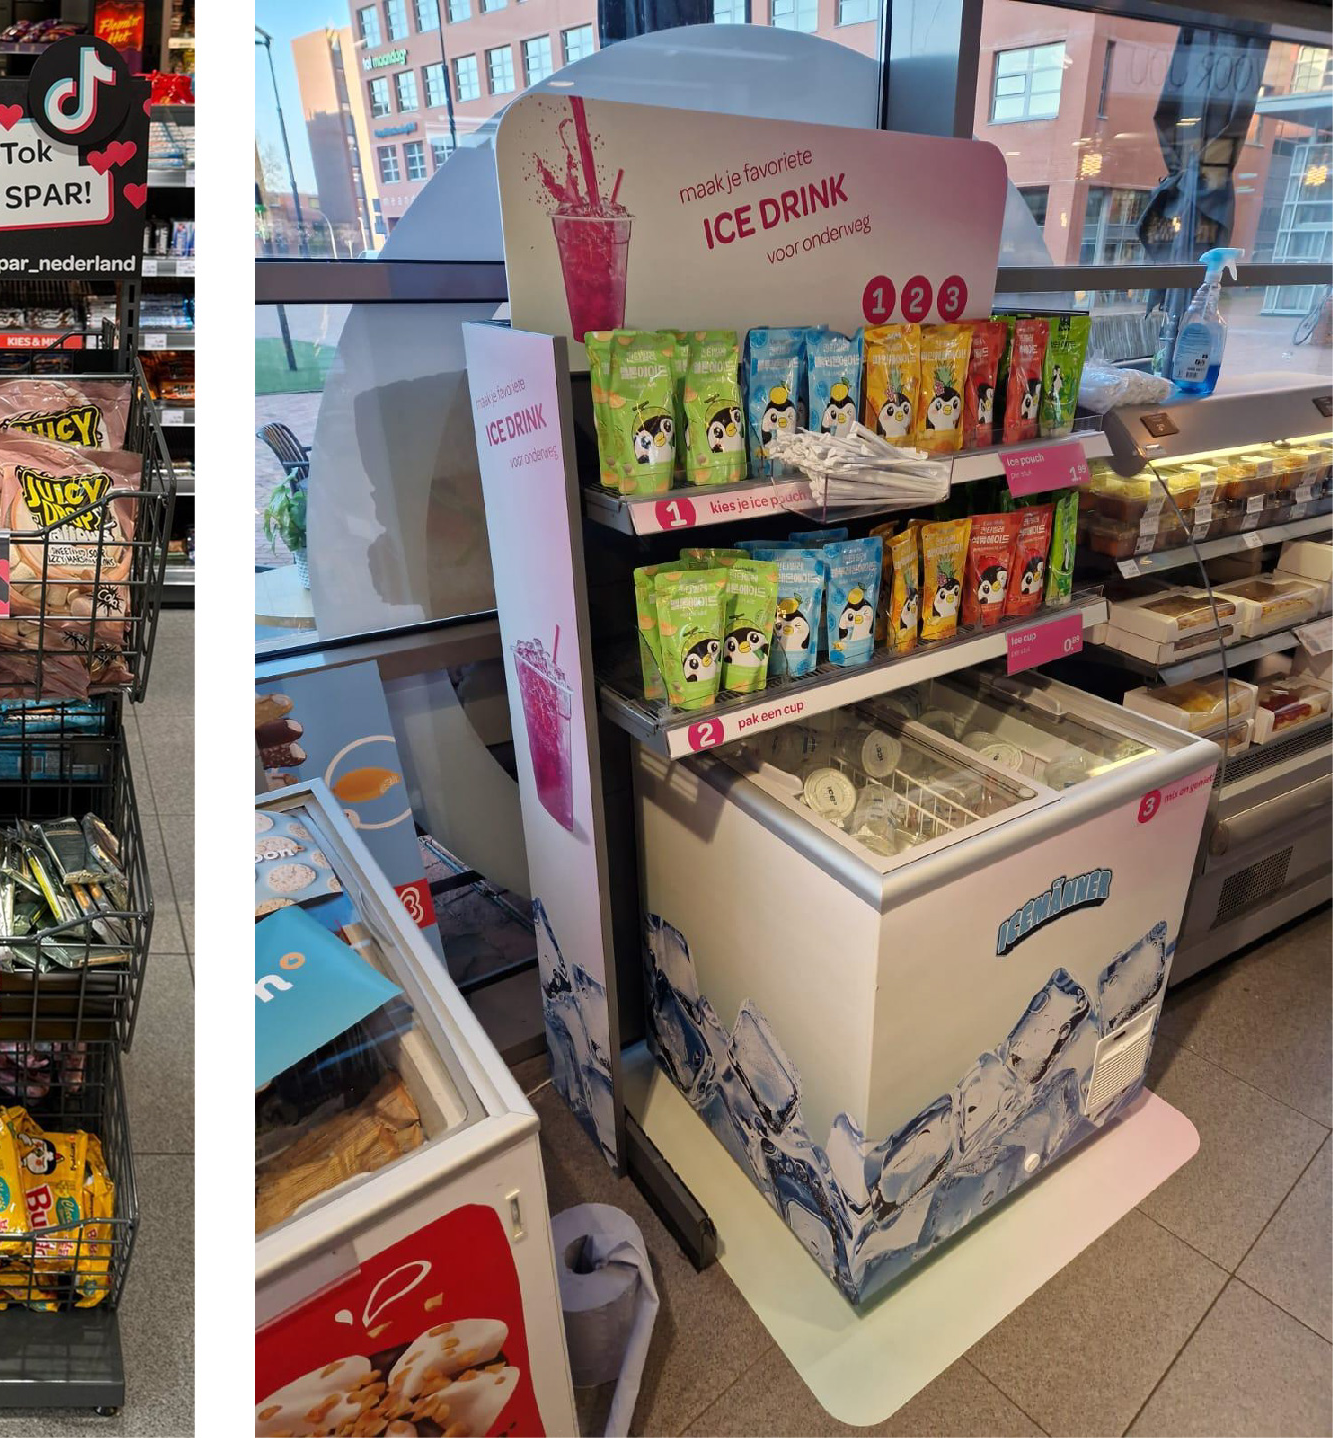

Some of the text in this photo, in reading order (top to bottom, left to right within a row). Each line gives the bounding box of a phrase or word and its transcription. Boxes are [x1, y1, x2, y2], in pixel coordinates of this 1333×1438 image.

[5, 181, 92, 209] SPAR!
[679, 148, 813, 203] maak je favoriete
[703, 172, 849, 250] ICE DRINK
[766, 214, 871, 264] voor onderweg
[871, 286, 959, 314] 1 2 3
[7, 337, 29, 346] KIES
[485, 403, 547, 447] ICE DRINK
[27, 476, 103, 508] JUICY
[666, 489, 806, 527] 1 kies je ice pouch
[697, 701, 804, 748] 2 pak een cup
[1143, 797, 1156, 816] 3
[997, 868, 1112, 956] ICEMÄNNER
